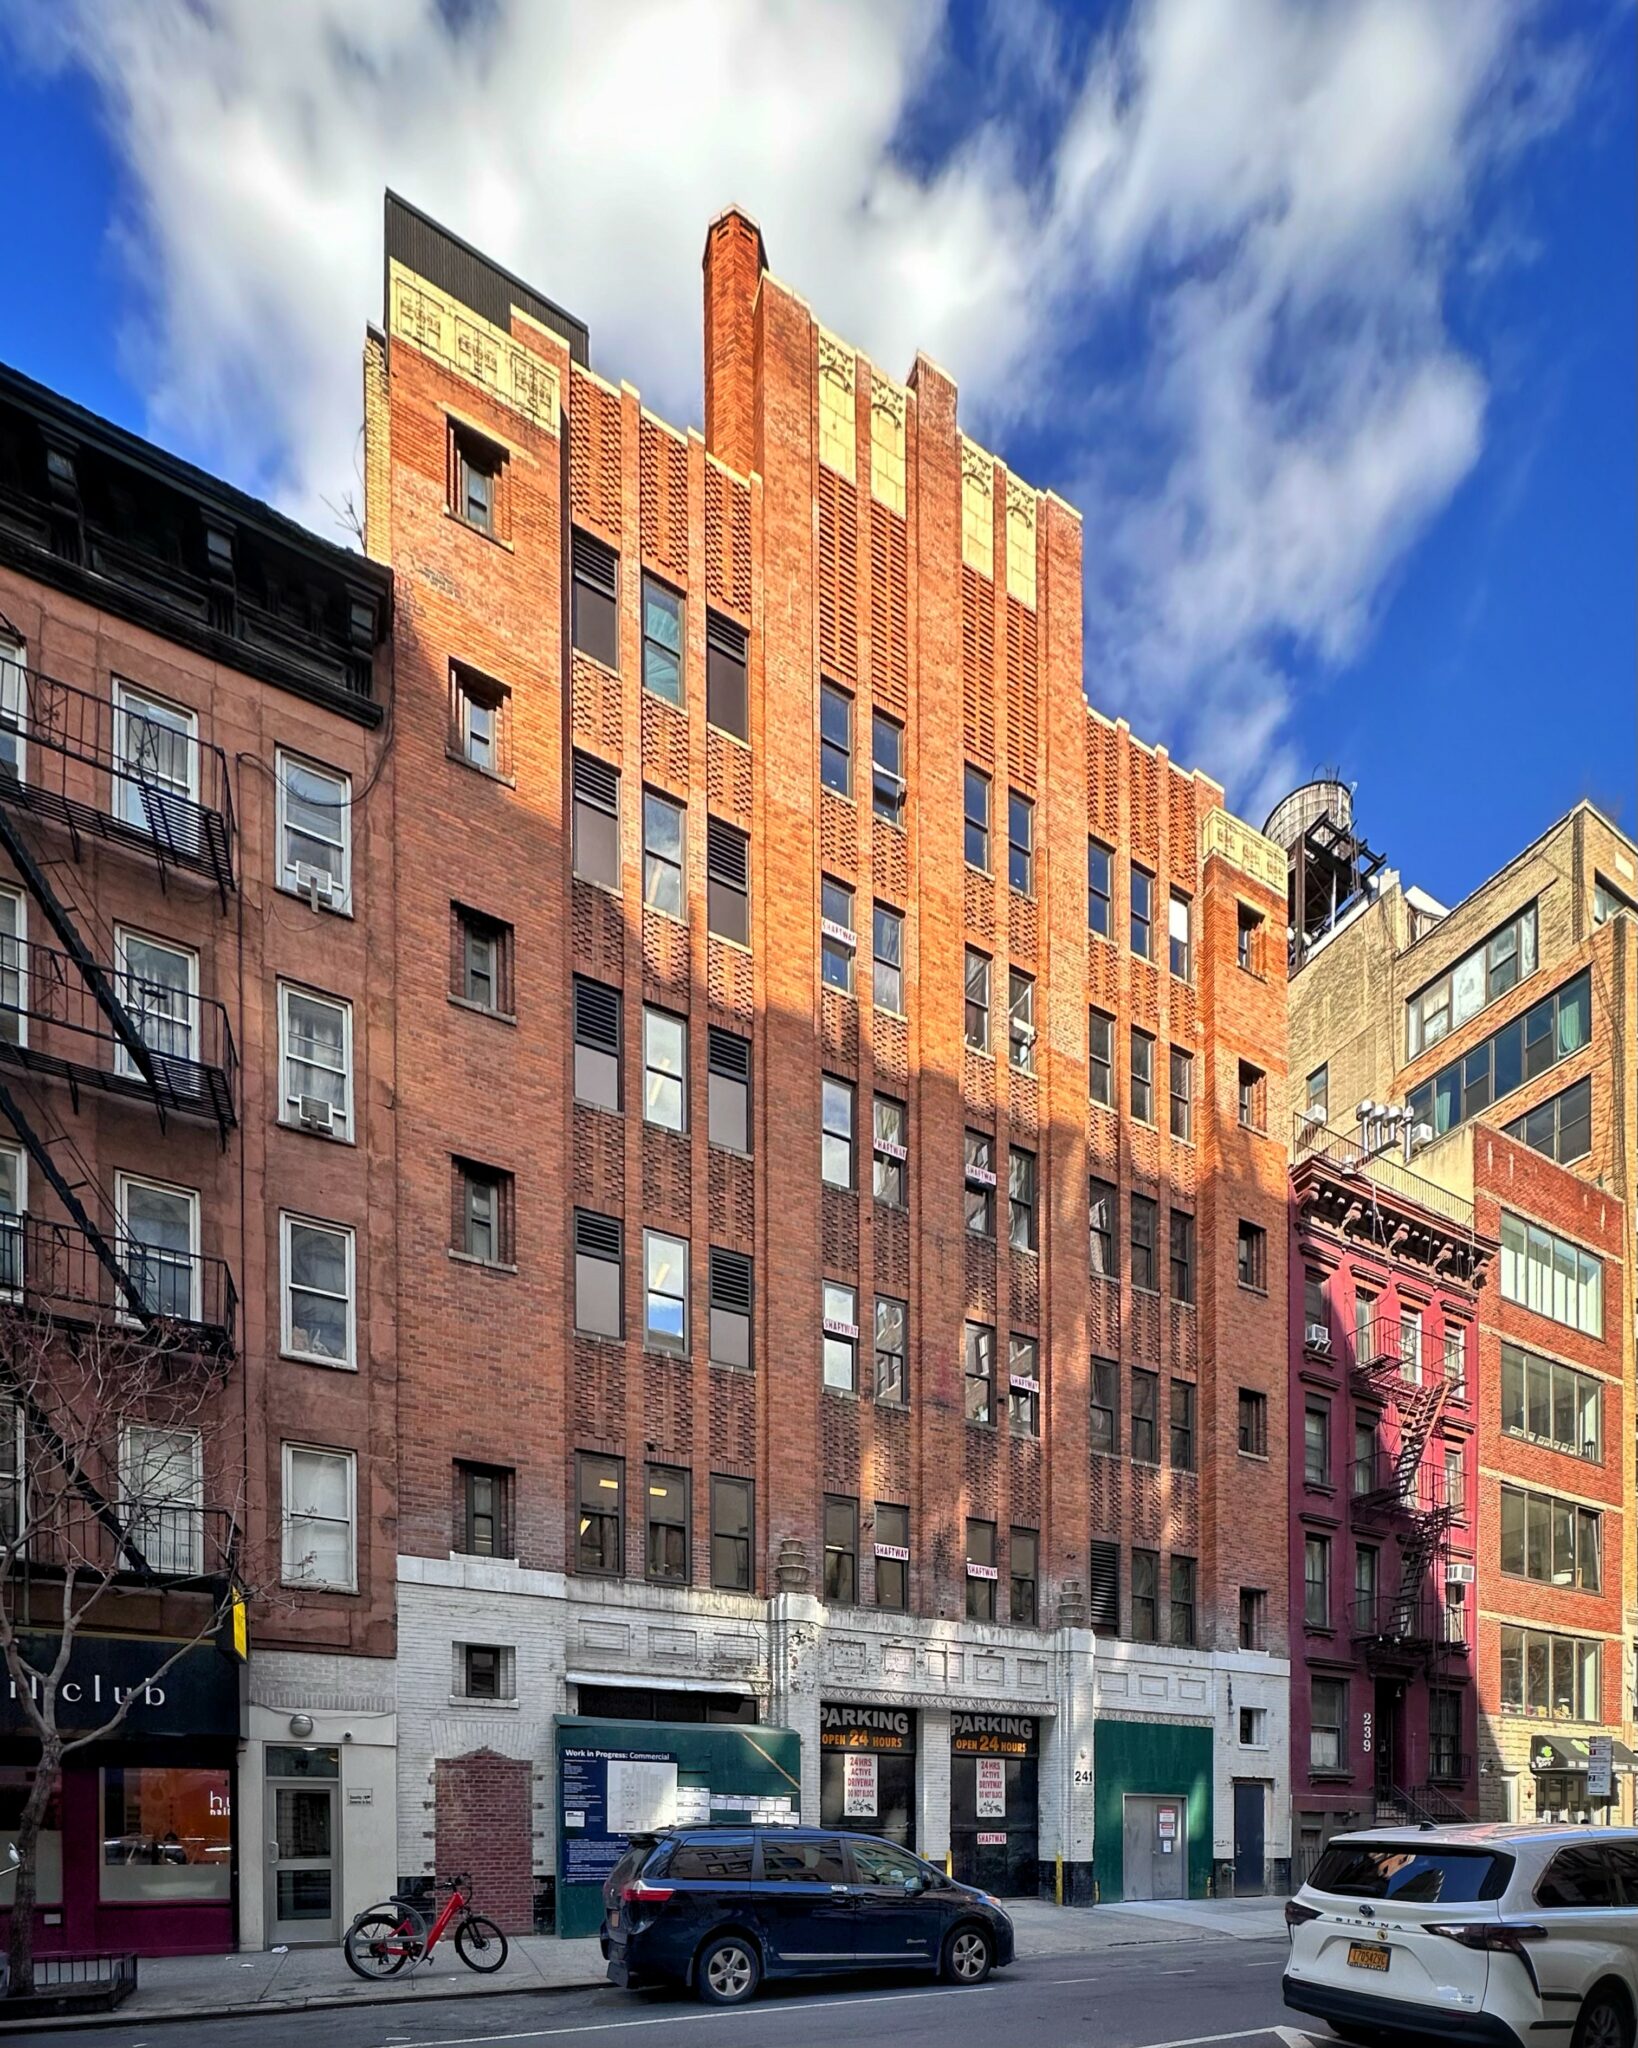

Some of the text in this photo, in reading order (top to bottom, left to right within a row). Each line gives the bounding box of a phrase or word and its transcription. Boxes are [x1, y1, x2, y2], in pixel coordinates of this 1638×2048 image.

[966, 1165, 995, 1184] SHAFTWAY
[825, 1319, 857, 1337] SHAFTWAY
[1011, 1375, 1038, 1391] SHAFTWAY
[875, 1544, 908, 1559] SHAFTWAY
[967, 1564, 997, 1578] SHAFTWAY
[61, 1674, 165, 1706] club
[820, 1707, 909, 1734] PARKING
[950, 1714, 1033, 1739] PARKING
[821, 1729, 903, 1748] OPEN 24 HOURS
[1363, 1712, 1372, 1752] 239
[955, 1734, 1027, 1753] OPEN 24 HOURS
[565, 1749, 585, 1757] Work
[596, 1751, 628, 1759] Progress:
[629, 1752, 670, 1760] Commercial
[851, 1768, 872, 1776] ACTIVE
[982, 1771, 1000, 1779] ACTIVE
[1075, 1770, 1093, 1782] 241
[848, 1778, 875, 1787] DRIVEWAY
[979, 1780, 1003, 1789] DRIVEWAY
[848, 1789, 875, 1798] DO NOT BLOCK
[978, 1833, 1006, 1844] SHAFTWAY
[1336, 1917, 1402, 1930] SIENNA
